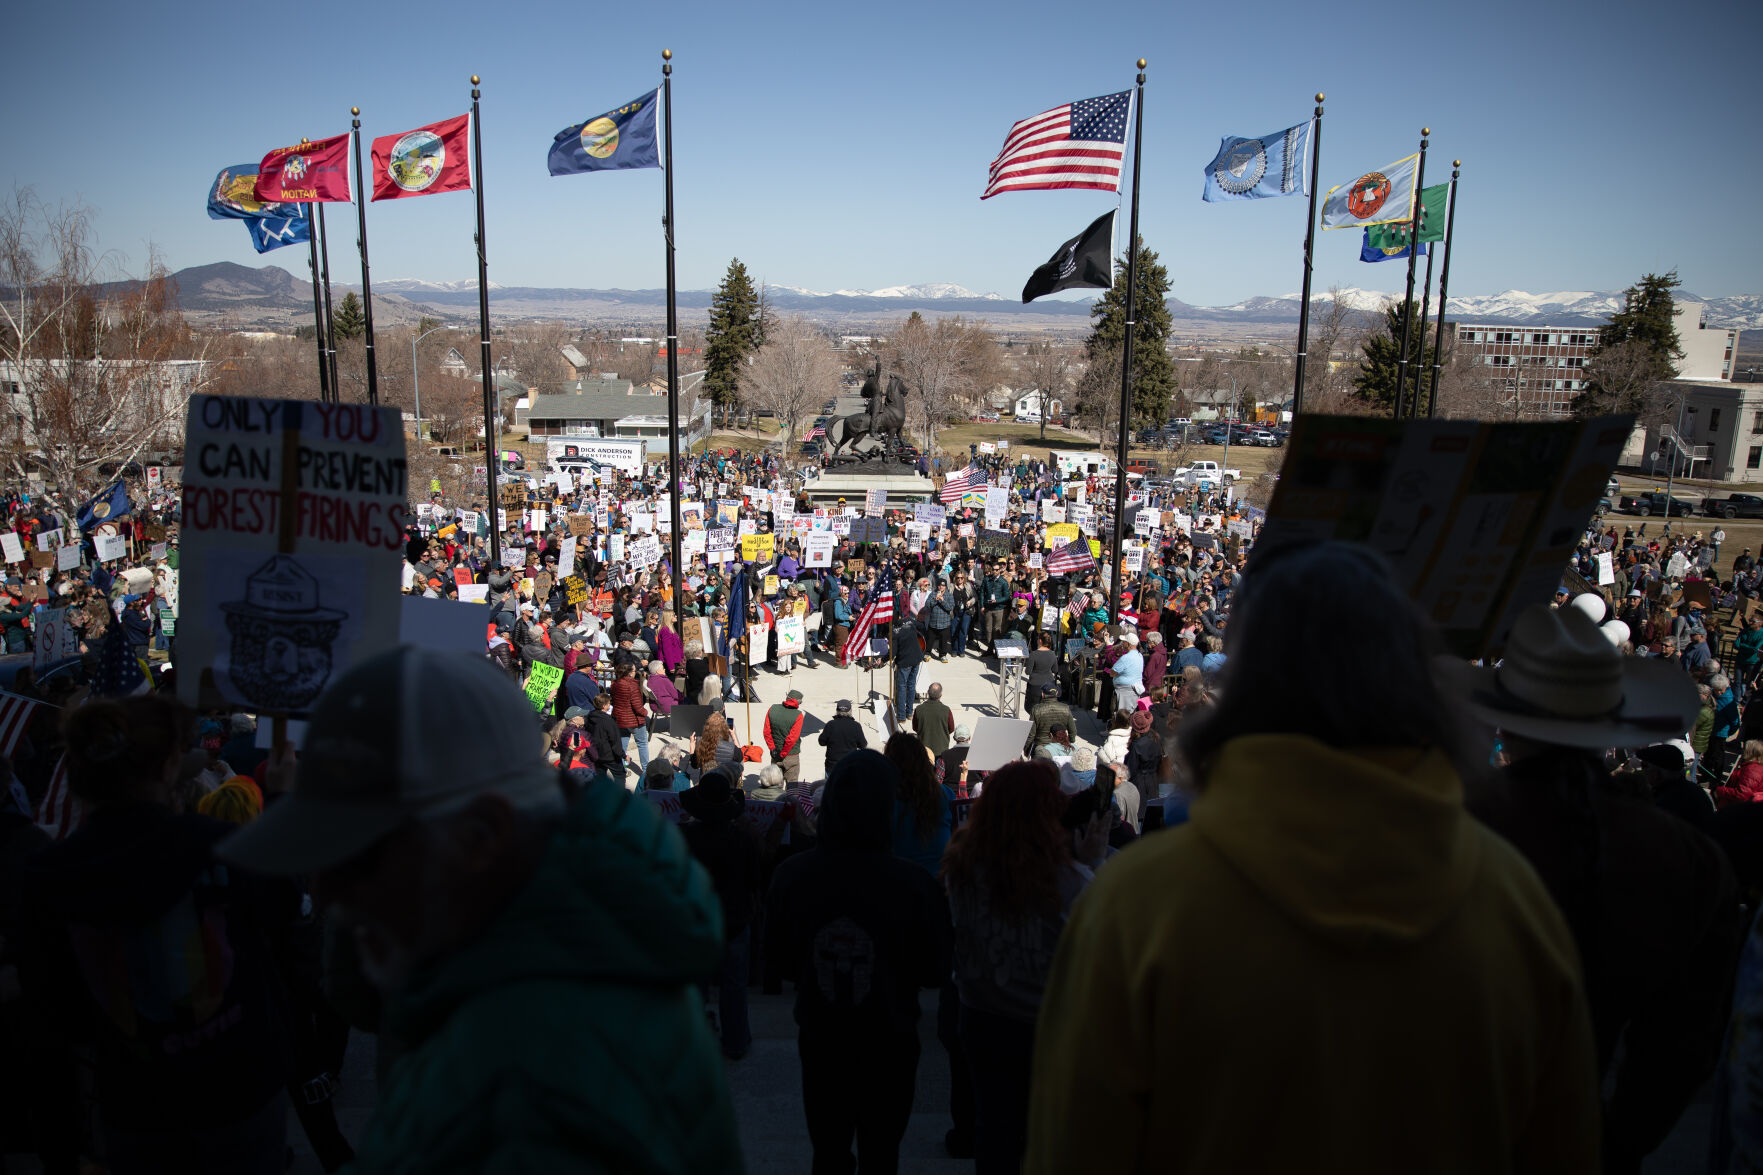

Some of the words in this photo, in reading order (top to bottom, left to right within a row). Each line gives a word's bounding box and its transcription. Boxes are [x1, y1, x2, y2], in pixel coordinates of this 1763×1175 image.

[203, 396, 281, 433] ONLY
[315, 402, 379, 443] YOU
[199, 443, 270, 480] CAN
[296, 448, 407, 496] PREVENT
[506, 484, 523, 493] WE
[181, 486, 282, 534] FOREST
[295, 491, 406, 551] FIRINGS
[533, 662, 537, 670] A
[540, 665, 559, 679] WORLD
